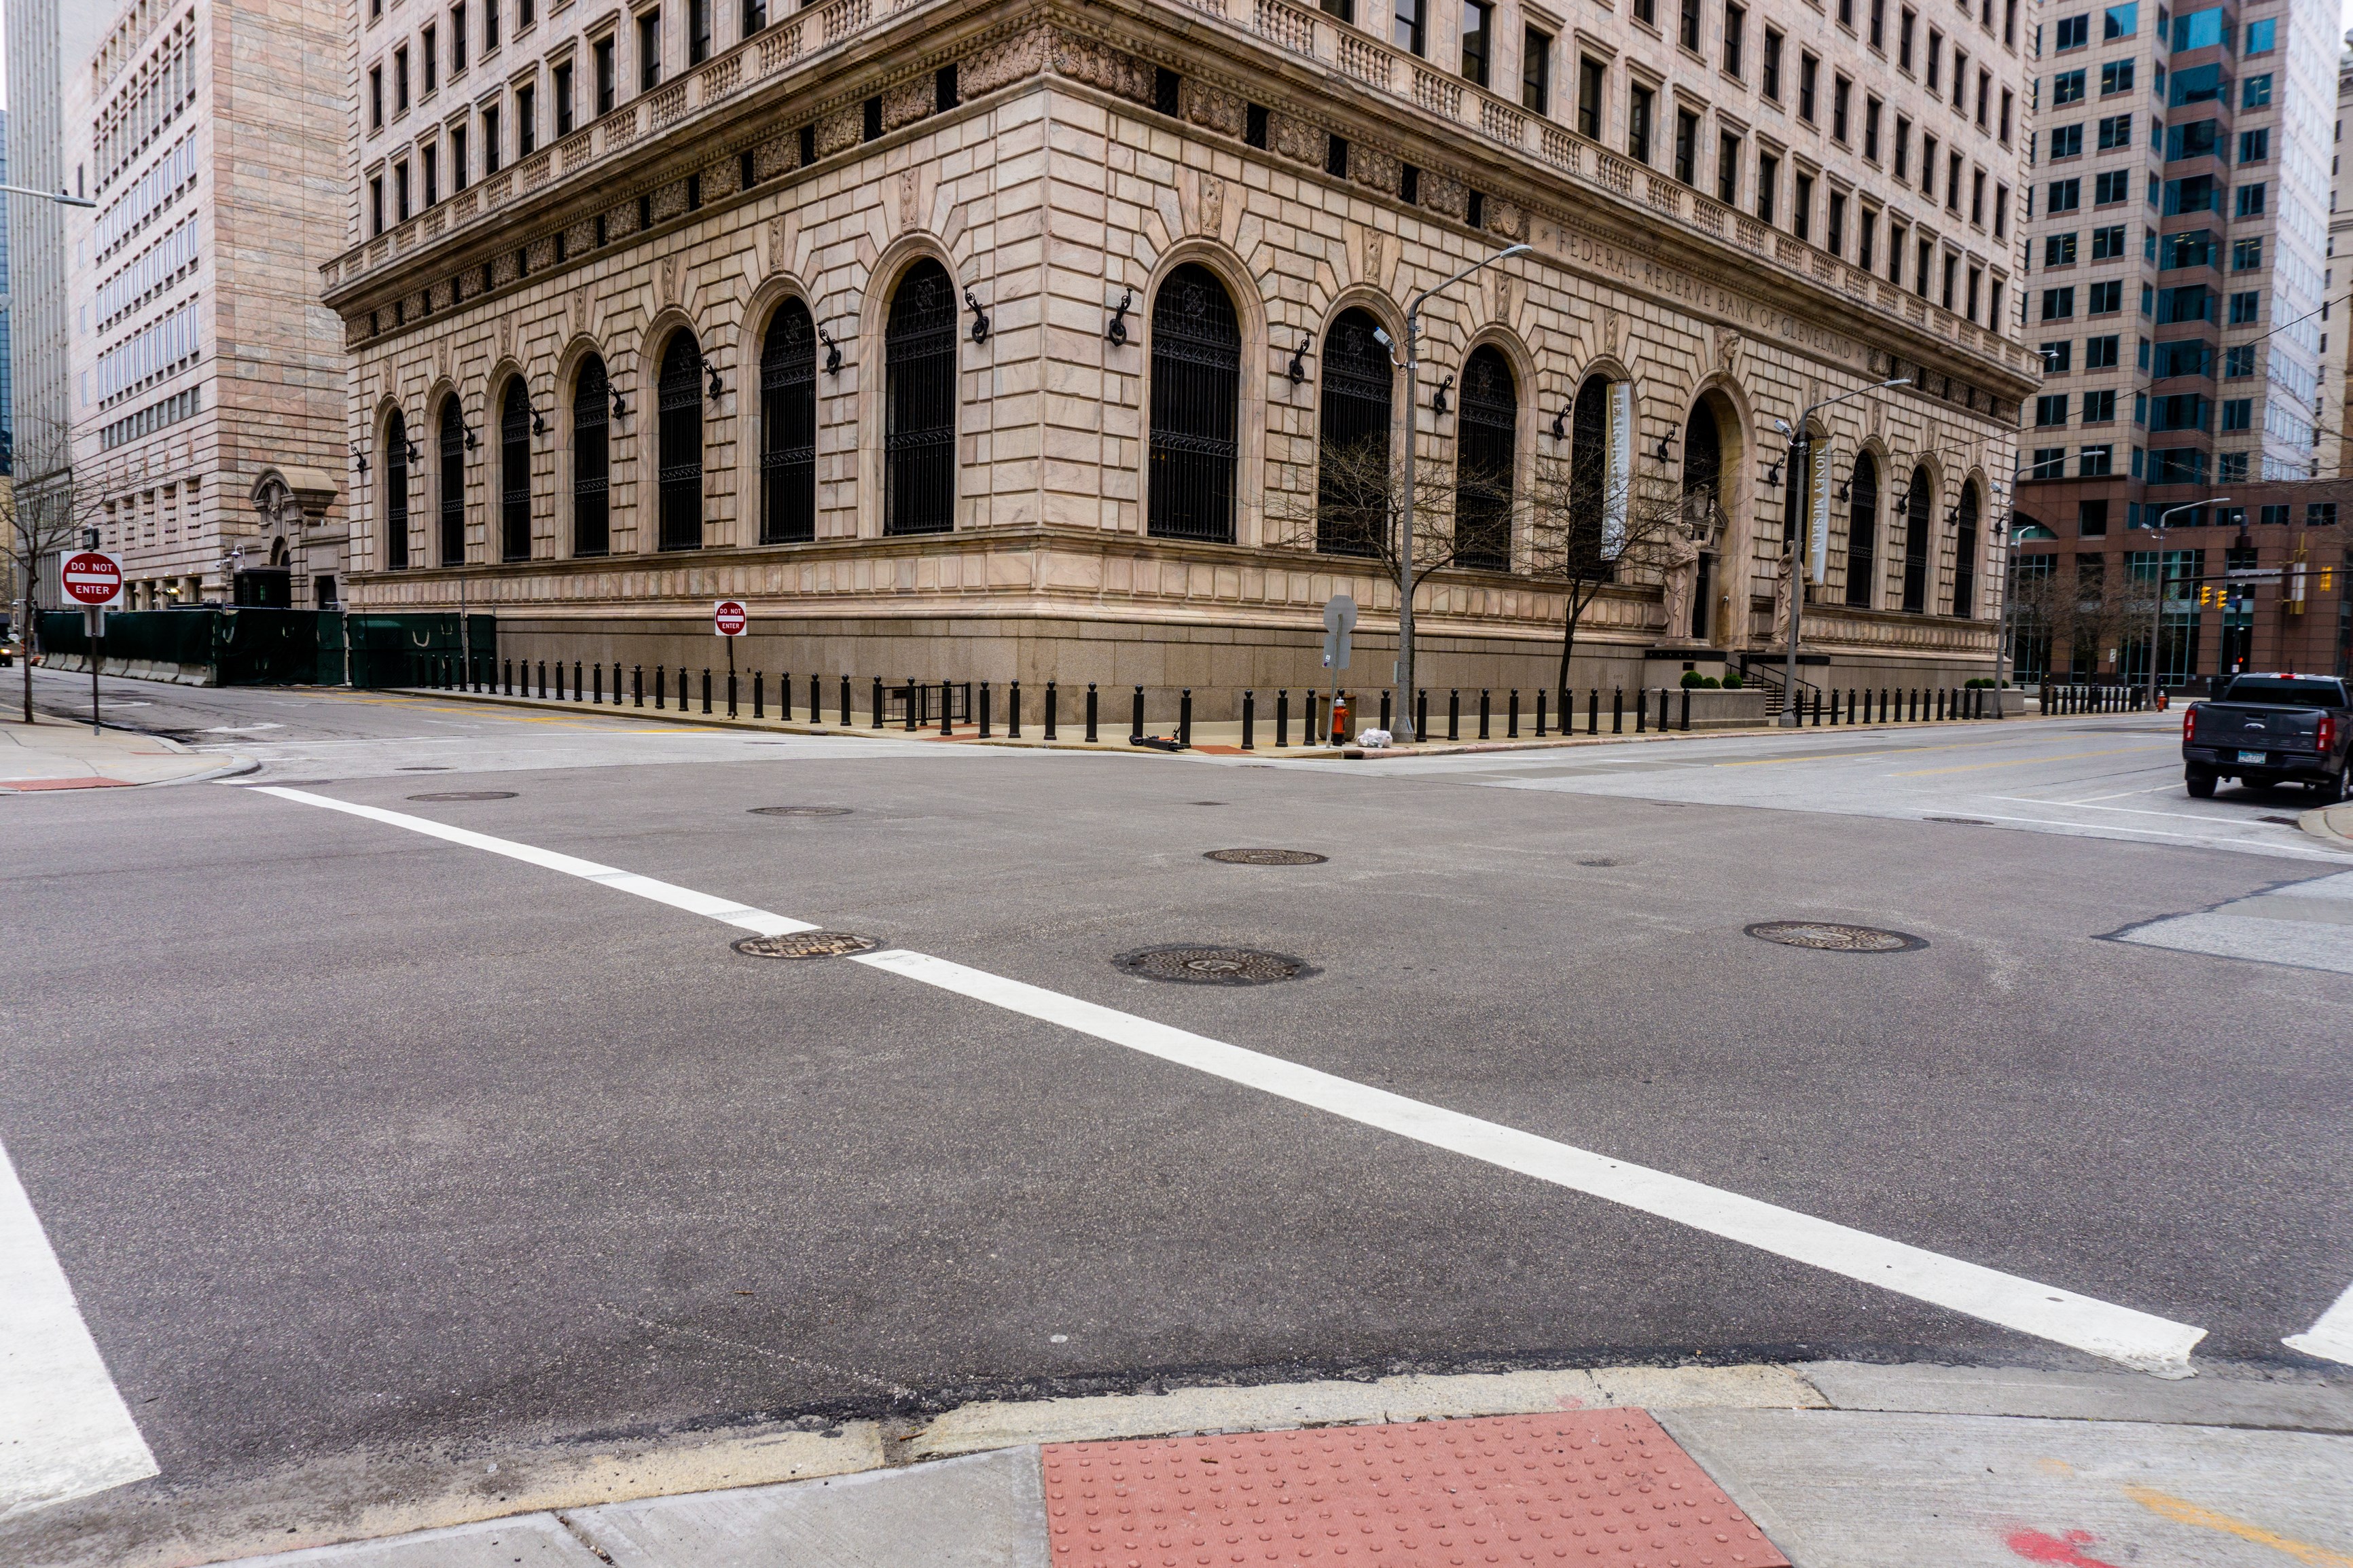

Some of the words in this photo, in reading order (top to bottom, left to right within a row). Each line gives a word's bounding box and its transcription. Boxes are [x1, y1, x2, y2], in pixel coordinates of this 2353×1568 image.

[1559, 229, 1636, 279] FEDERAL
[1644, 263, 1711, 307] RESERVE
[1718, 292, 1754, 324] BANK
[1760, 309, 1776, 331] OF
[1782, 317, 1851, 359] CLEVELAND
[1611, 394, 1624, 474] LEARNING
[1814, 448, 1825, 494] MONEY
[1811, 498, 1825, 553] MUSEUM
[71, 562, 86, 570] DO
[92, 563, 113, 572] NOT
[75, 585, 109, 595] ENTER
